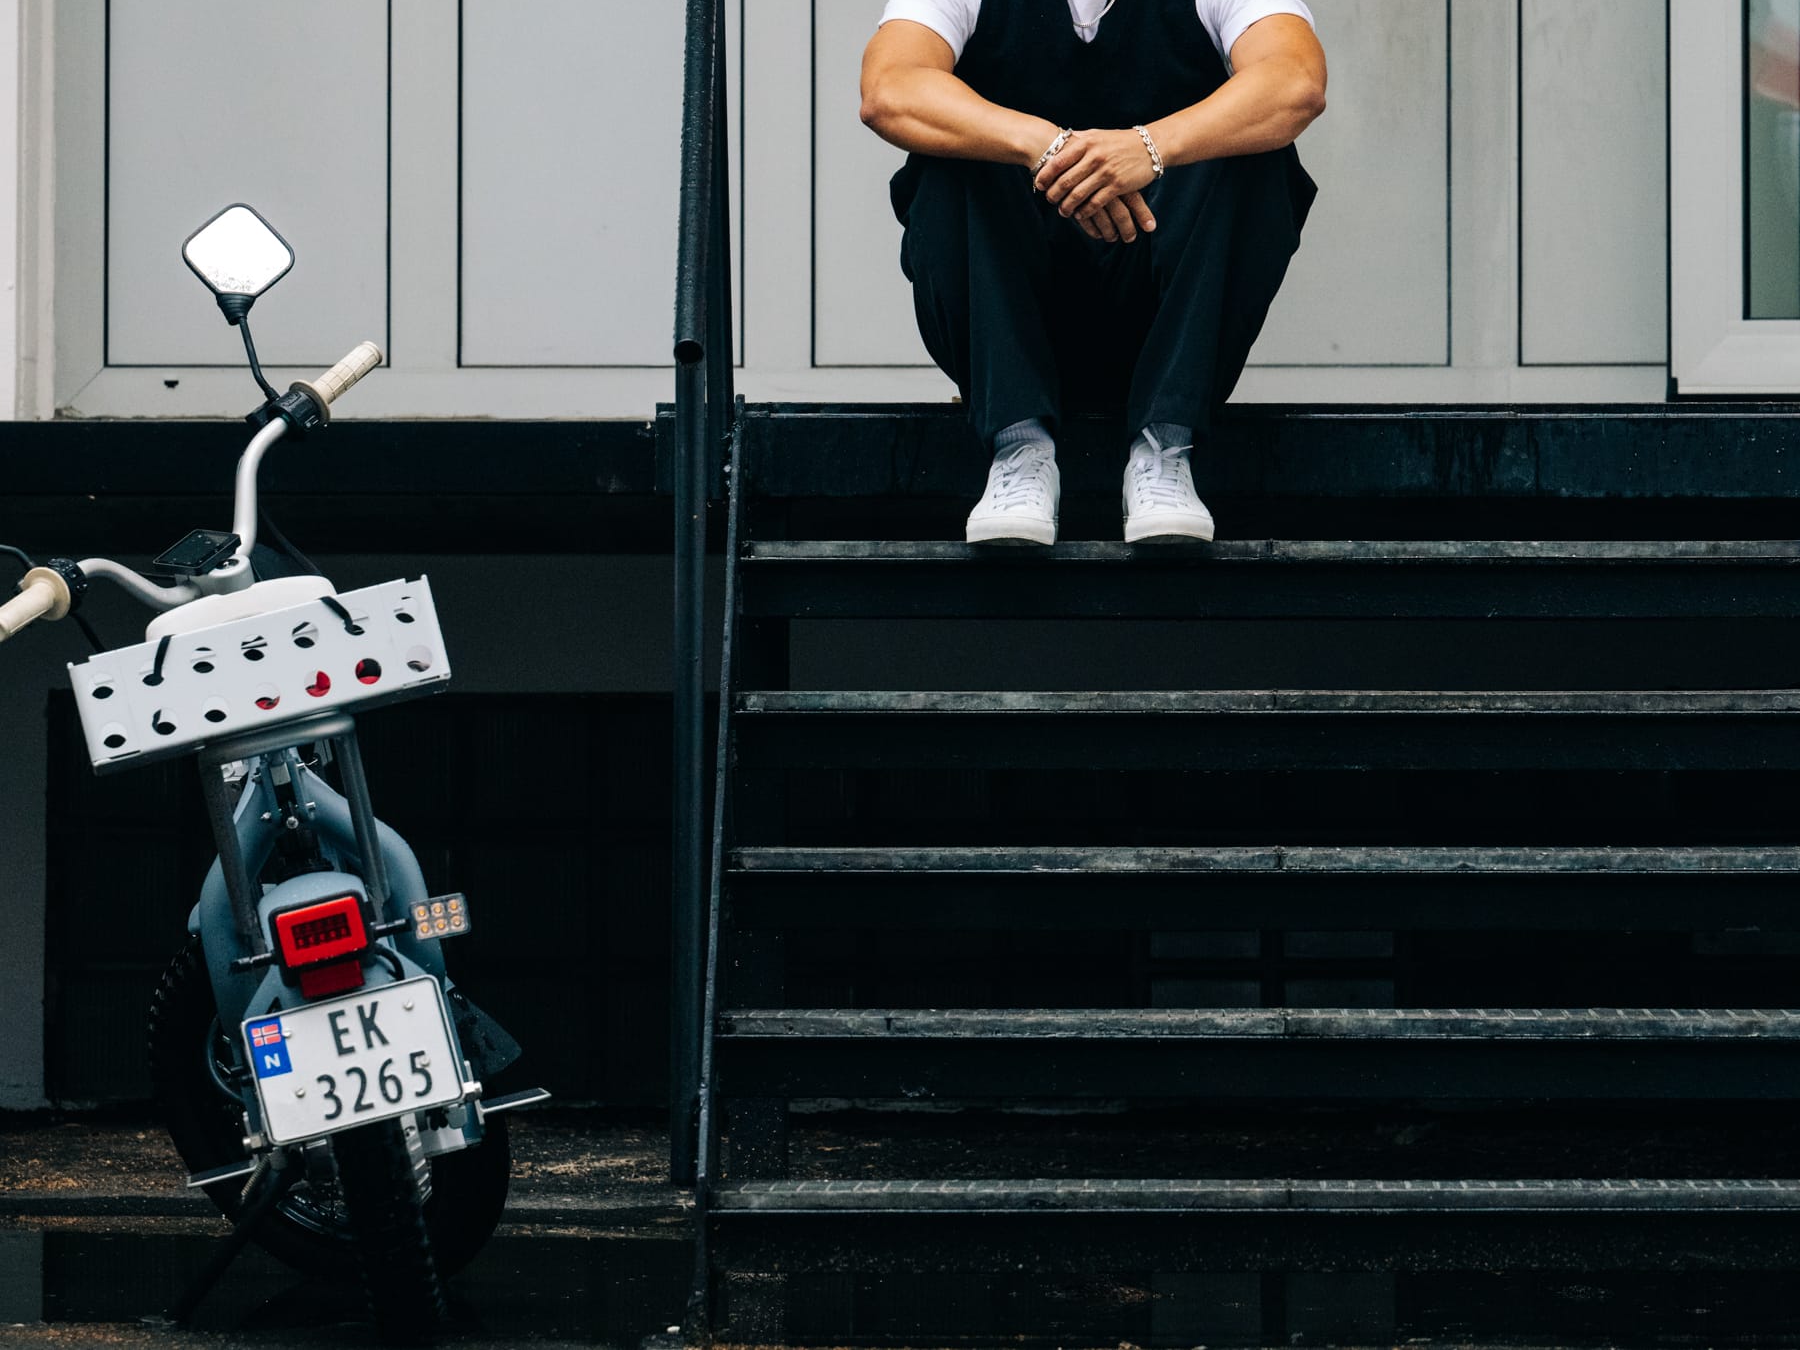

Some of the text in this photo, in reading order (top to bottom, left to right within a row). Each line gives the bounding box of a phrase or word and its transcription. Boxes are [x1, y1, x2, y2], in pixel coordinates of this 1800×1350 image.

[327, 1001, 390, 1056] EK
[263, 1052, 281, 1070] N
[316, 1050, 433, 1120] 3265
